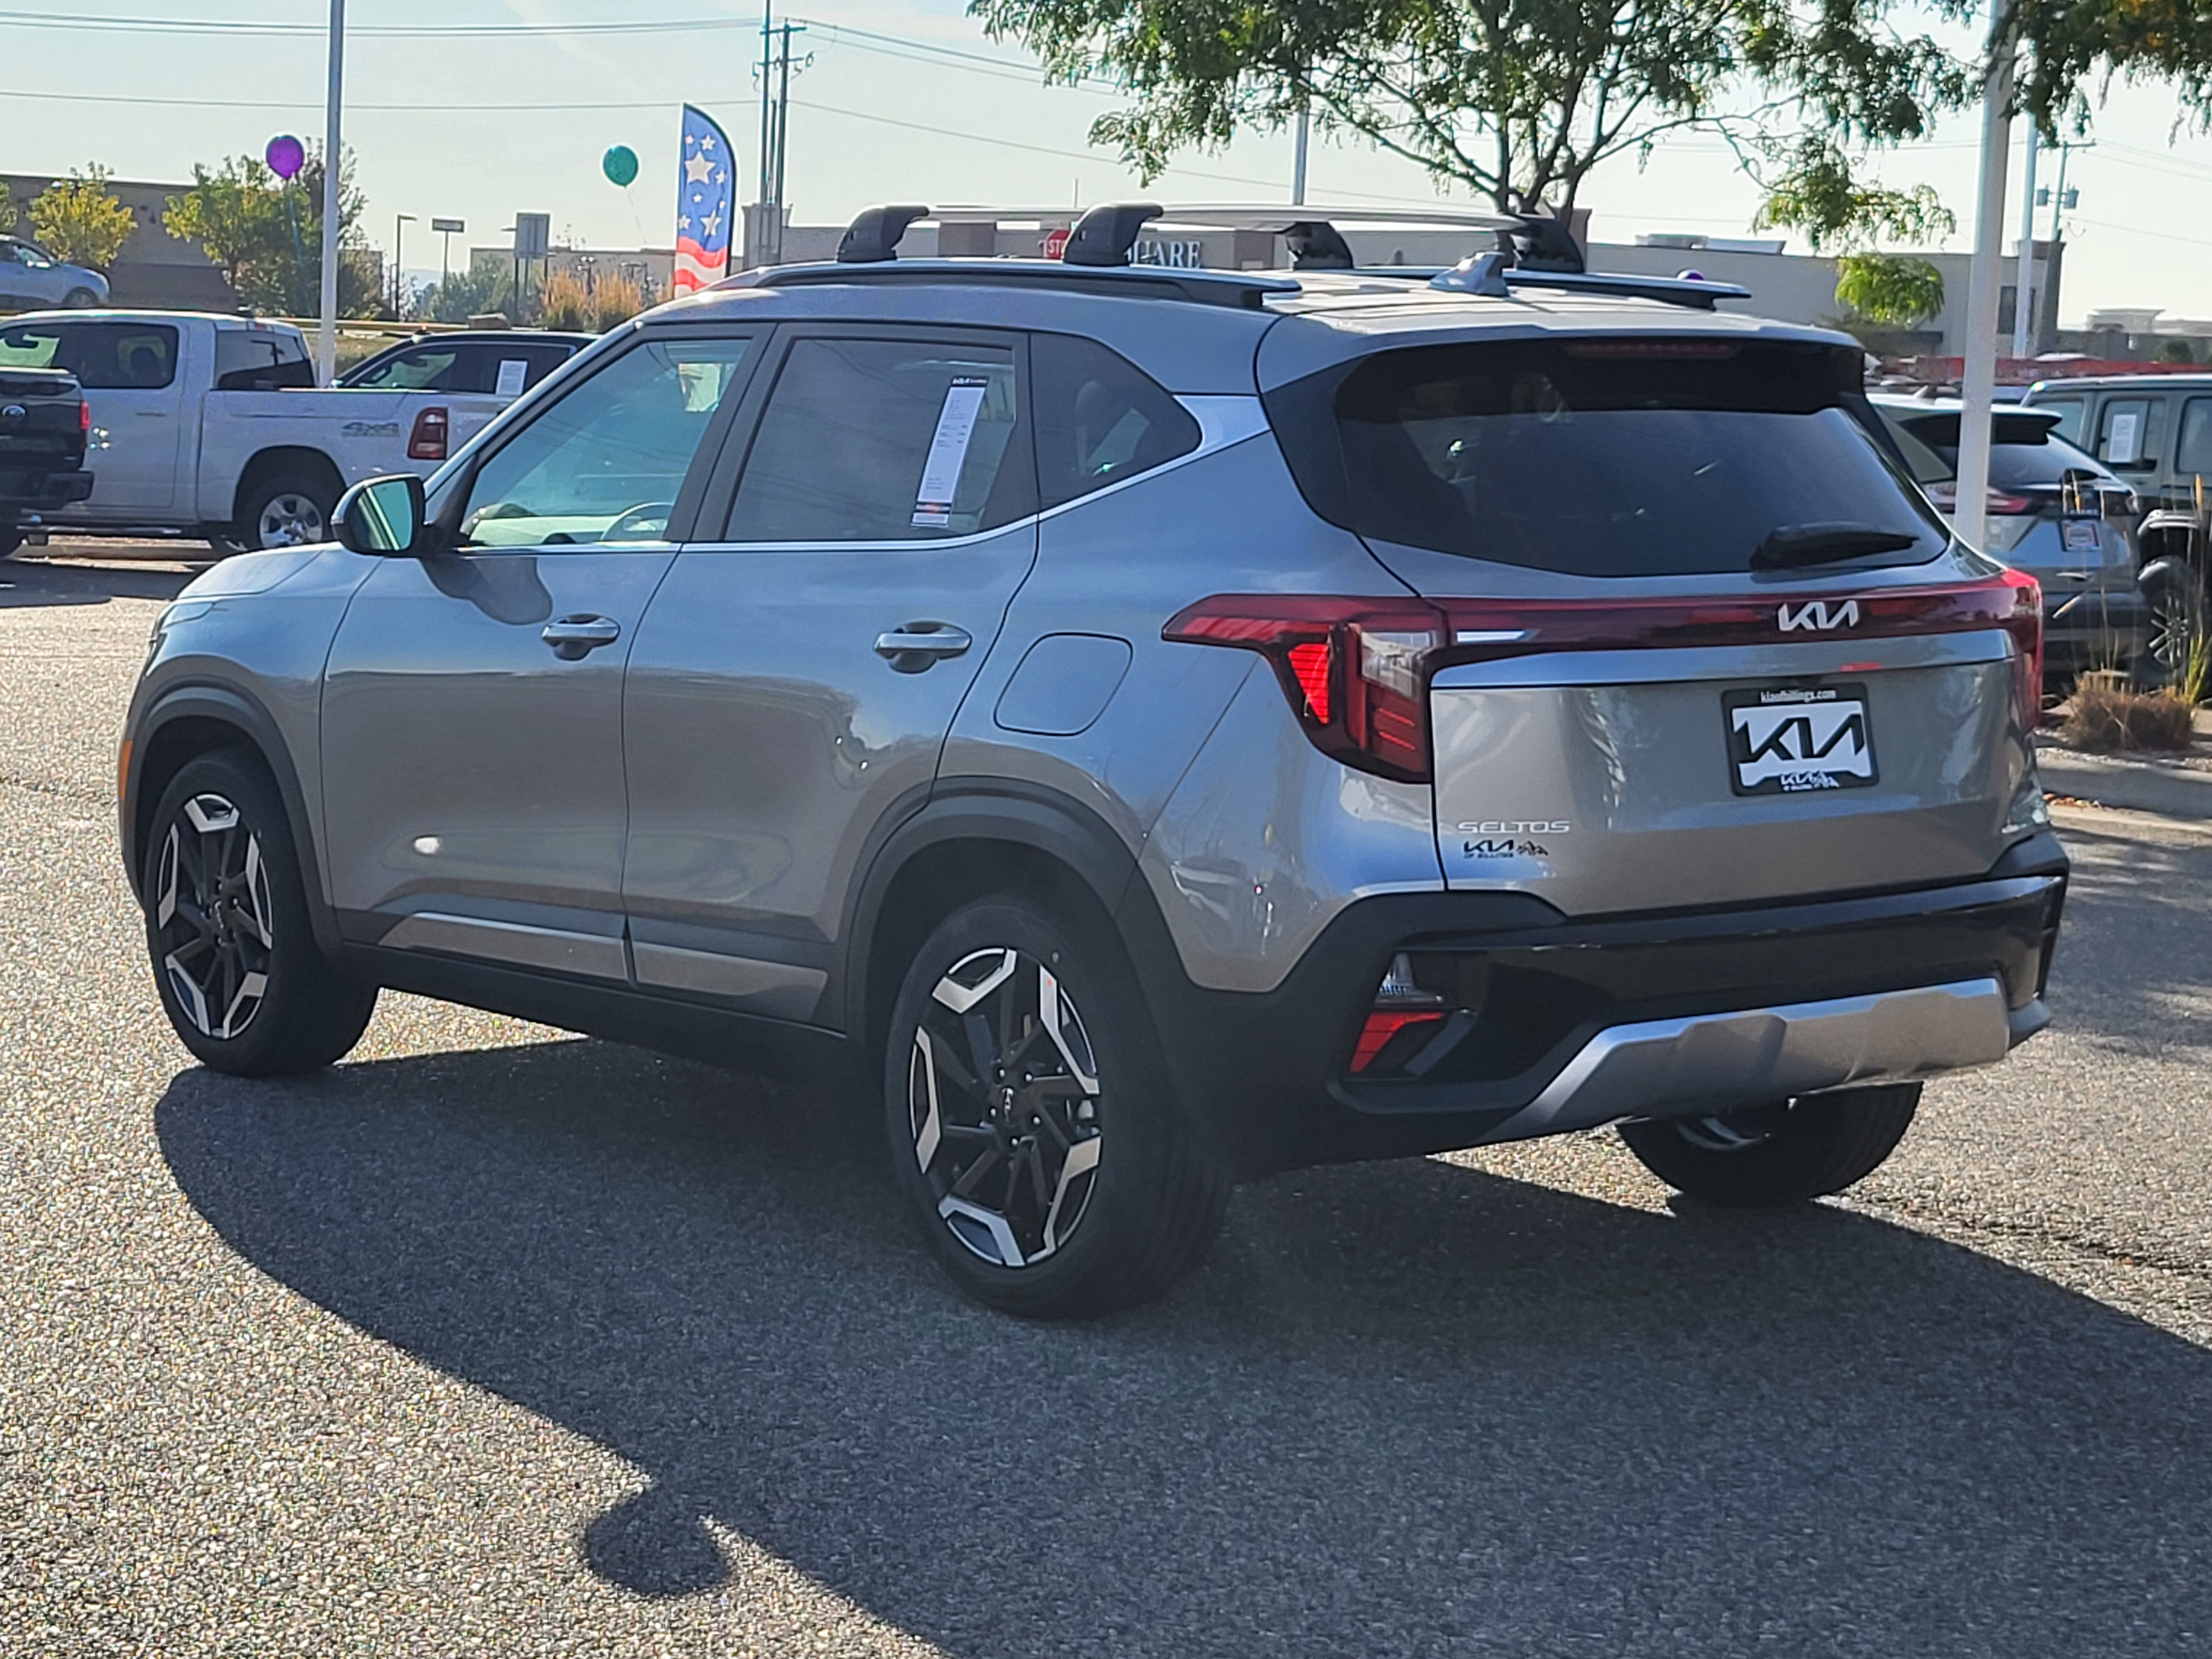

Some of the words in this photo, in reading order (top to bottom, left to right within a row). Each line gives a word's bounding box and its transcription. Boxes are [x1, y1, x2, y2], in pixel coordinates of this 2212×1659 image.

[1123, 240, 1201, 269] UARE
[1778, 600, 1859, 631] KIA
[1732, 713, 1865, 764] KIA
[1458, 821, 1570, 833] SELTOS
[1464, 839, 1514, 852] KIA
